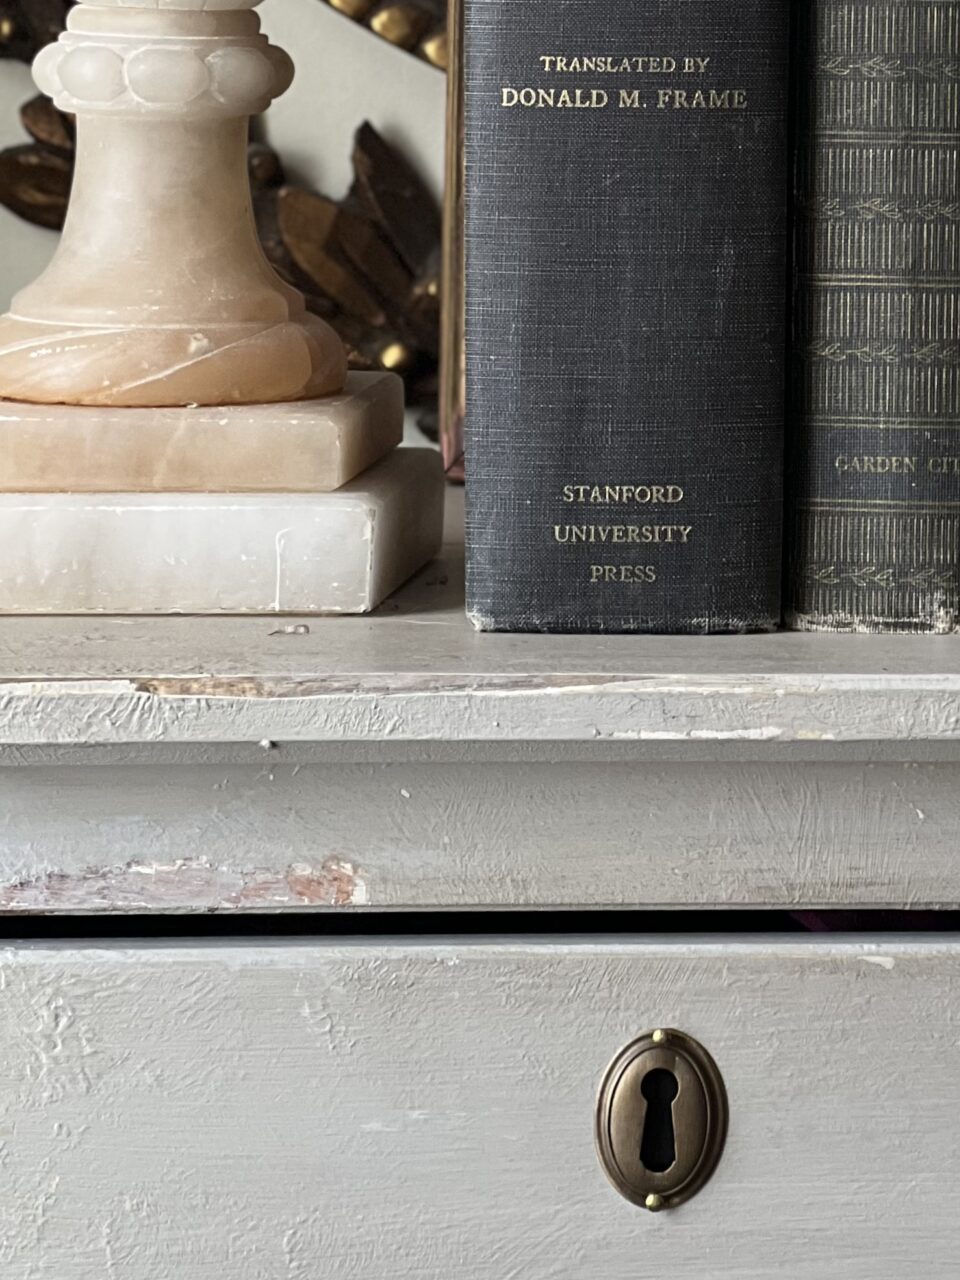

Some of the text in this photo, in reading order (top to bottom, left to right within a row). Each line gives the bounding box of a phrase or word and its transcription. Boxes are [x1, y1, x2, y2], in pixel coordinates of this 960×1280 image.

[540, 56, 710, 74] TRANSLATED BY
[501, 88, 748, 109] DONALD M. FRAME
[835, 455, 917, 474] GARDEN
[562, 484, 684, 504] STANFORD
[553, 524, 693, 543] UNIVERSITY
[590, 564, 656, 583] PRESS
